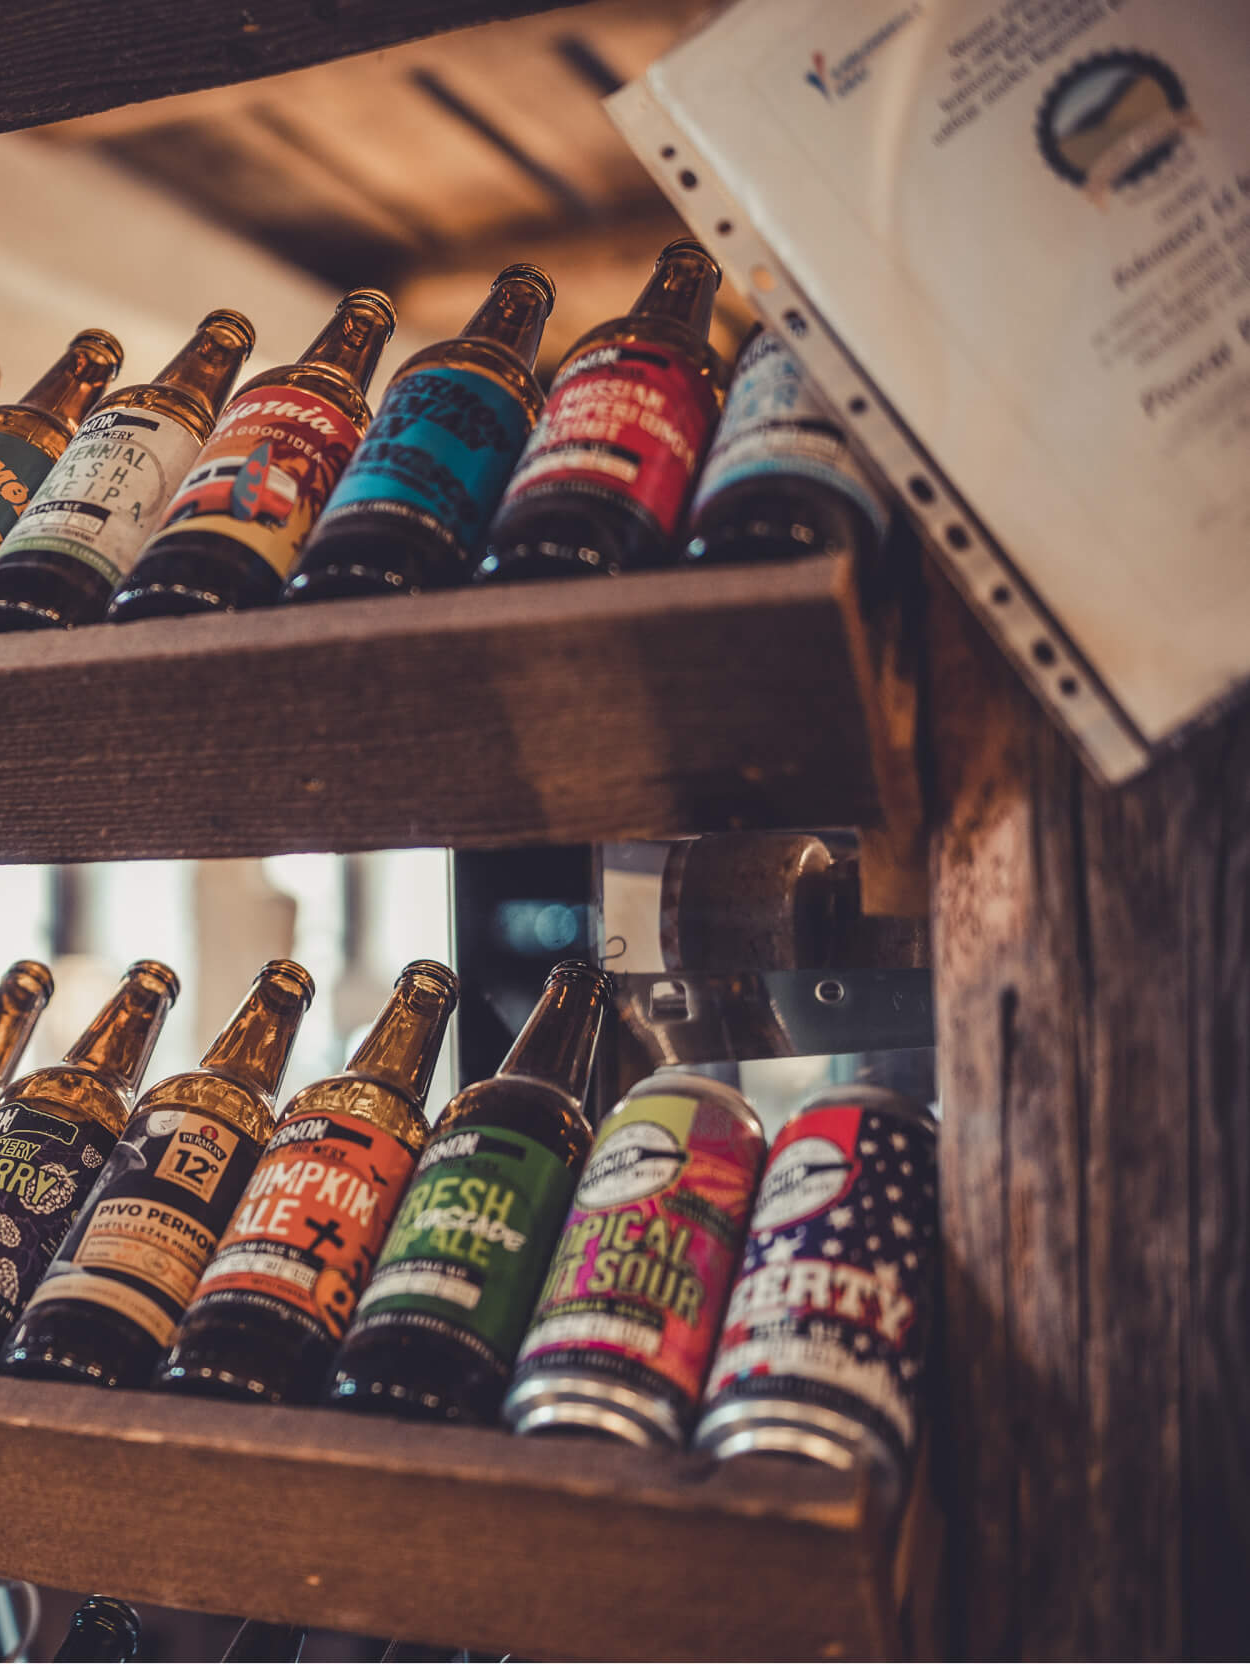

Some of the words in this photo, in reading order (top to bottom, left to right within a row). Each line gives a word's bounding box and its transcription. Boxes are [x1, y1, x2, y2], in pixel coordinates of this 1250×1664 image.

[236, 424, 286, 441] GOOD
[286, 433, 324, 465] IDEA
[181, 1132, 225, 1161] PERMON
[266, 1118, 331, 1152] ERMON
[173, 1148, 220, 1185] 12°
[97, 1203, 144, 1218] PIVO
[233, 1197, 302, 1238] ALE
[587, 1249, 707, 1330] SOUR
